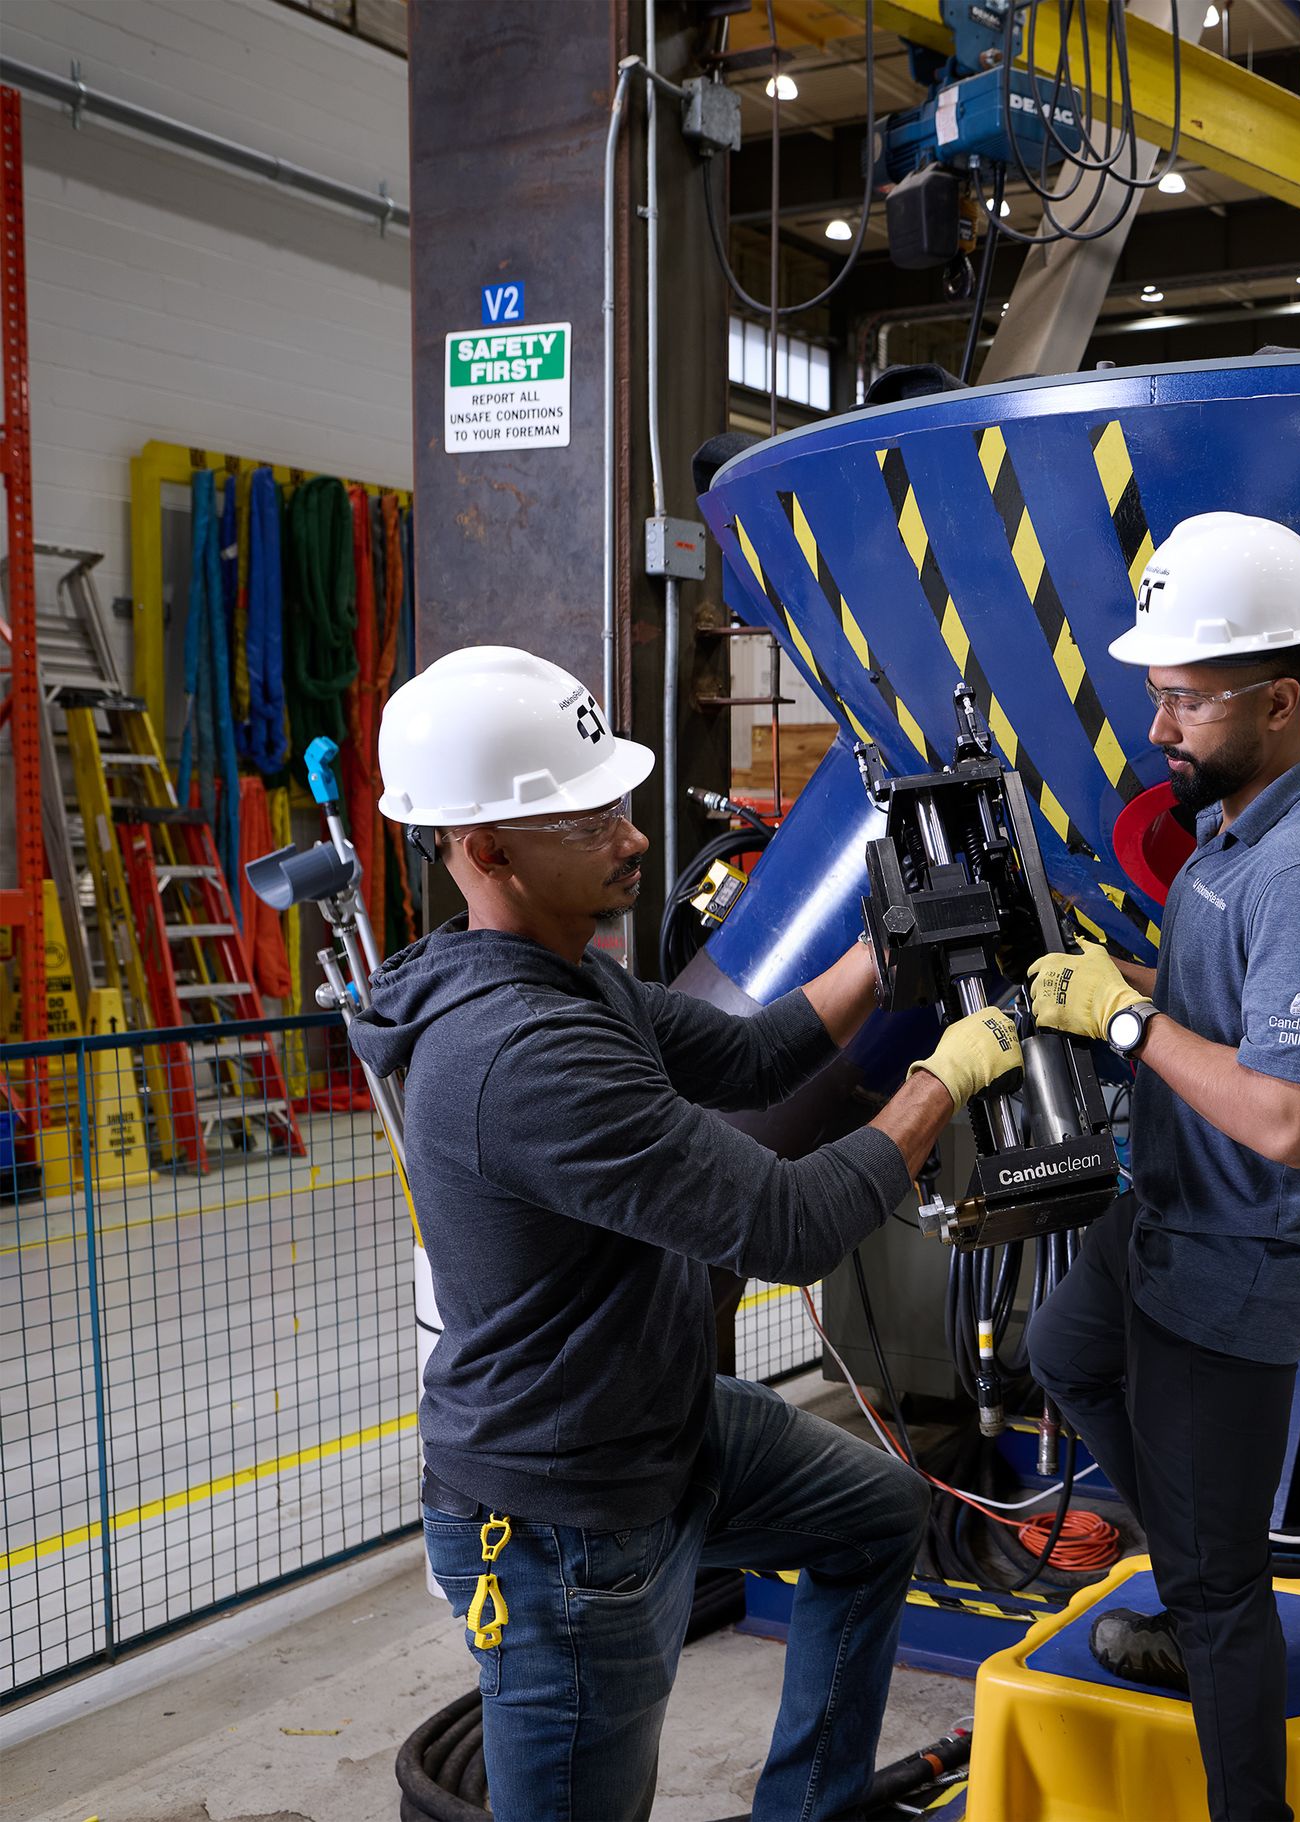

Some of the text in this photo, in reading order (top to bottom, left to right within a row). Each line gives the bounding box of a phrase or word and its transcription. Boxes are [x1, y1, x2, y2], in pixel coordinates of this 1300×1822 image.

[485, 286, 519, 321] V2
[458, 333, 557, 361] SAFETY
[471, 358, 542, 383] FIRST
[472, 391, 540, 405] REPORT ALL
[450, 407, 563, 424] UNSAFE CONDITIONS
[454, 425, 560, 441] TO YOUR FOREMAN
[1058, 968, 1074, 1005] BDG
[984, 1019, 1010, 1051] BDG
[999, 1154, 1101, 1185] Canduclean
